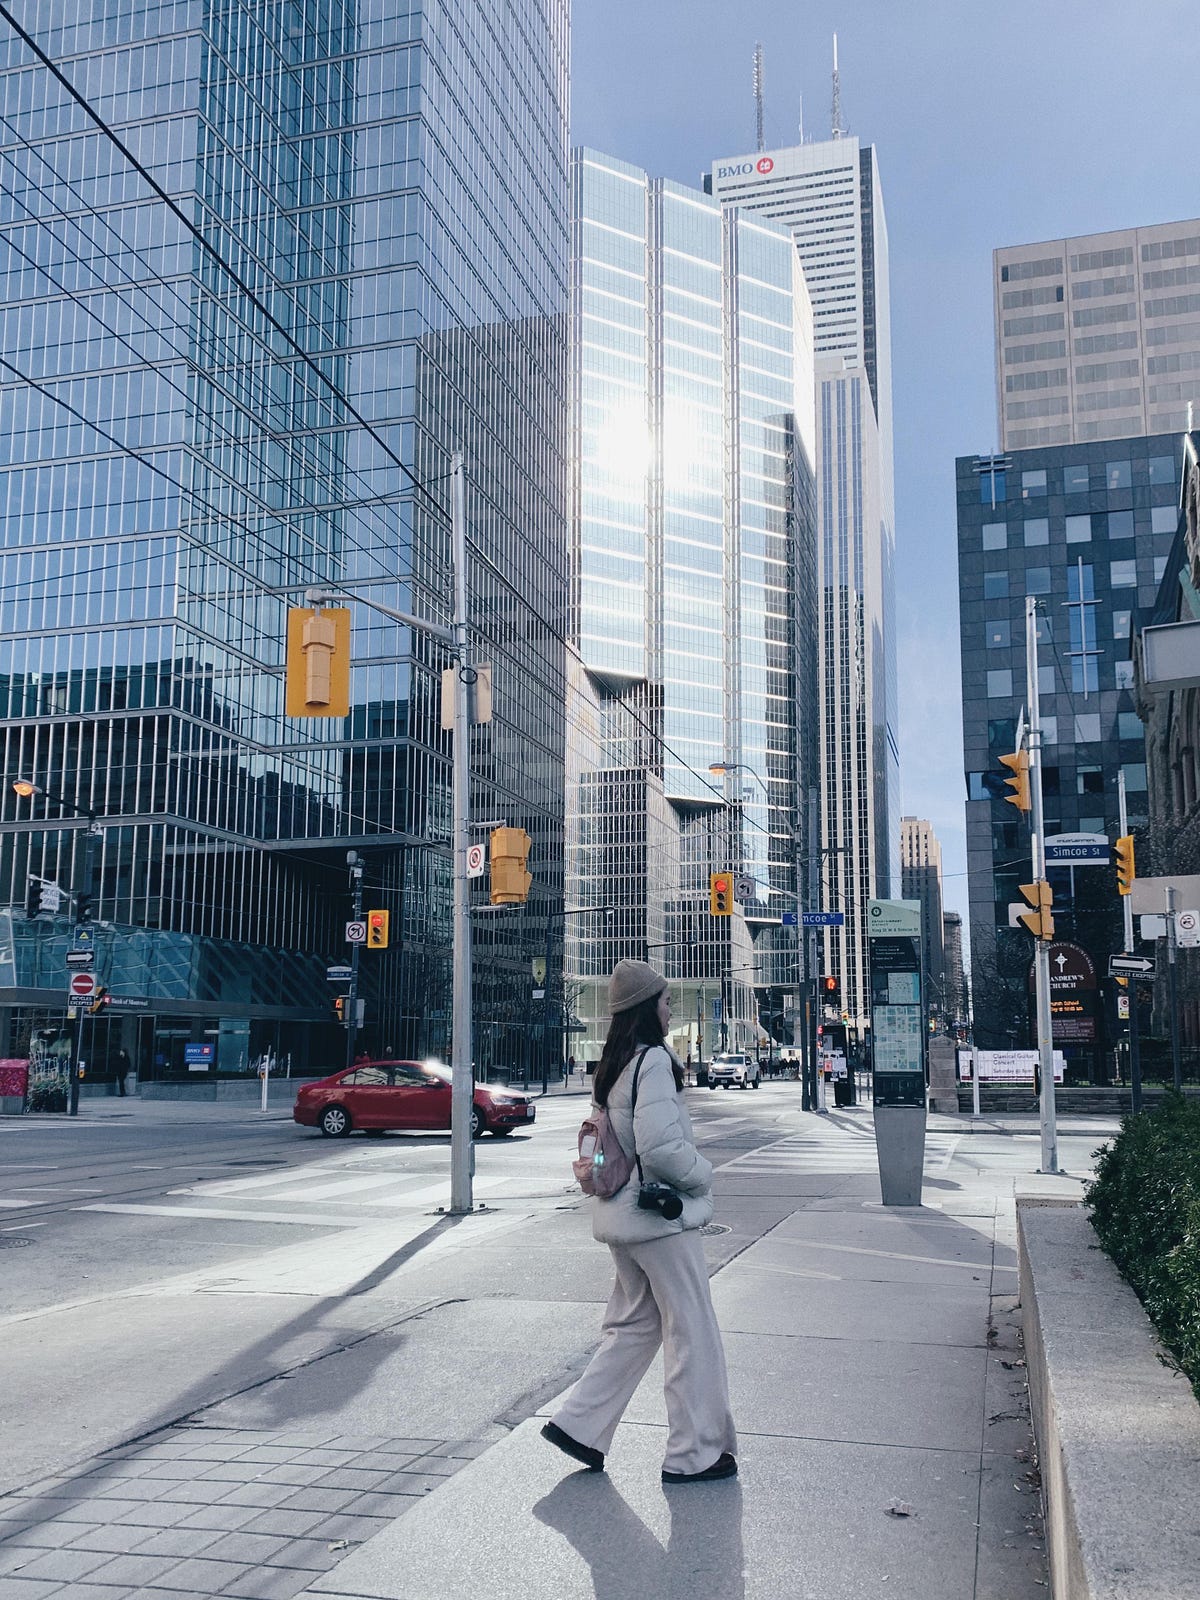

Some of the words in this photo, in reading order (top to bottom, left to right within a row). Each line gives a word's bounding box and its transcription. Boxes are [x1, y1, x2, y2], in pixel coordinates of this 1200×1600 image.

[717, 163, 753, 179] BMO
[1053, 847, 1087, 857] Simcoe
[1092, 847, 1100, 855] St
[791, 914, 827, 922] Smcoe
[1050, 974, 1085, 982] ANDREW'S
